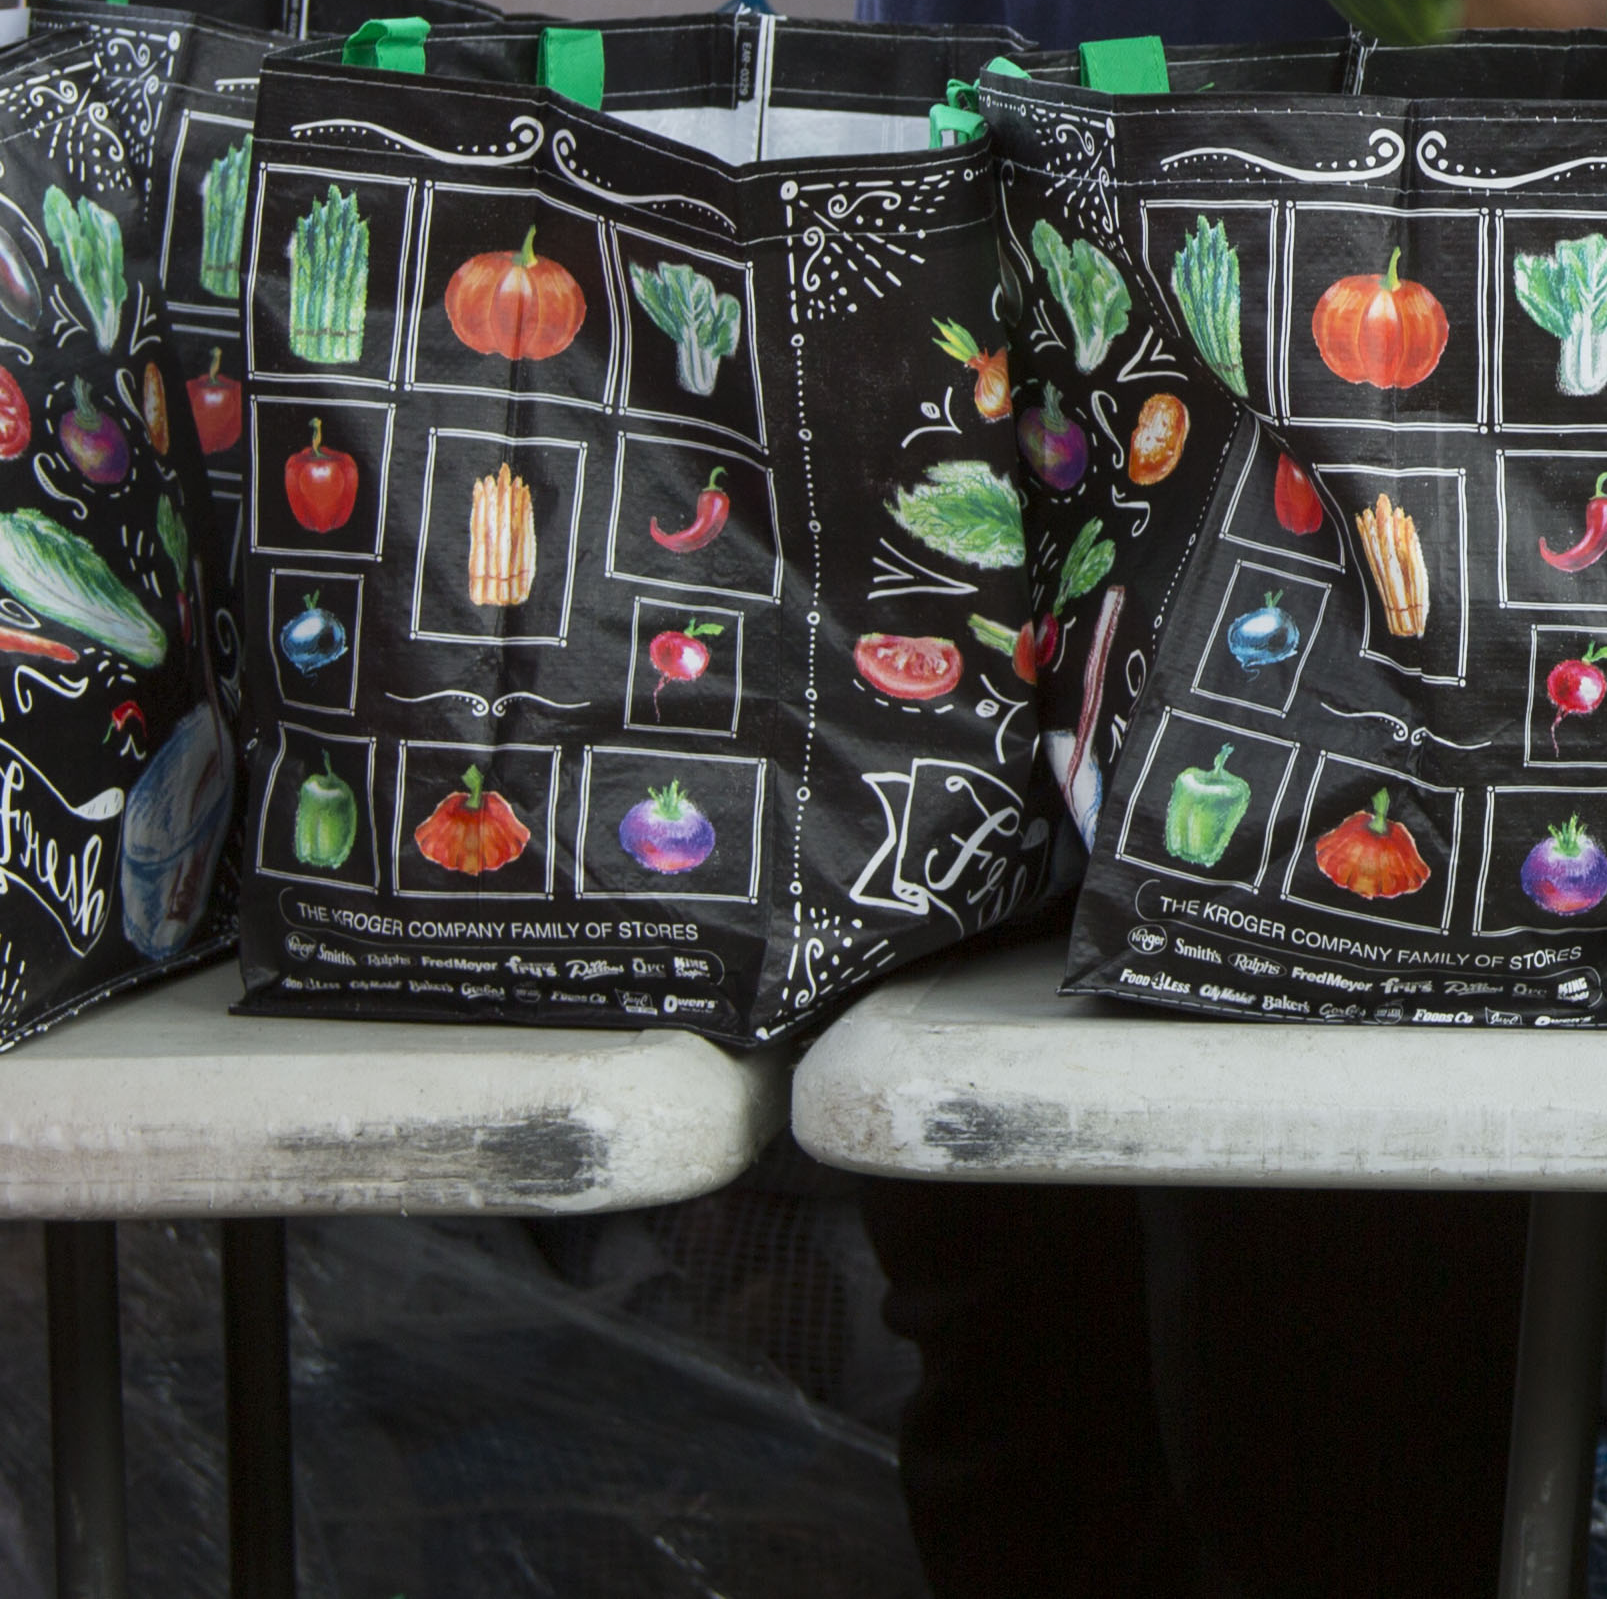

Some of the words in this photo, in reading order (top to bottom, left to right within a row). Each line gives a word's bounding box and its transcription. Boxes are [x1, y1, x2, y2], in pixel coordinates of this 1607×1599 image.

[297, 902, 330, 922] THE
[332, 909, 404, 937] KROGER
[408, 920, 505, 939] COMPANY
[511, 922, 580, 939] FAMILY
[585, 922, 612, 939] OF
[618, 921, 699, 941] STORES
[1160, 895, 1200, 916] THE
[1203, 902, 1286, 941] KROGER
[1291, 928, 1392, 963] COMPANY
[1398, 950, 1470, 966] FAMILY
[1475, 954, 1504, 968] OF
[1509, 946, 1583, 970] STORES
[1131, 929, 1165, 951] Kroger
[1174, 937, 1222, 964] Smith's
[1233, 953, 1281, 975] Ralphs
[1557, 977, 1588, 993] KING
[1262, 995, 1311, 1013] Baker's
